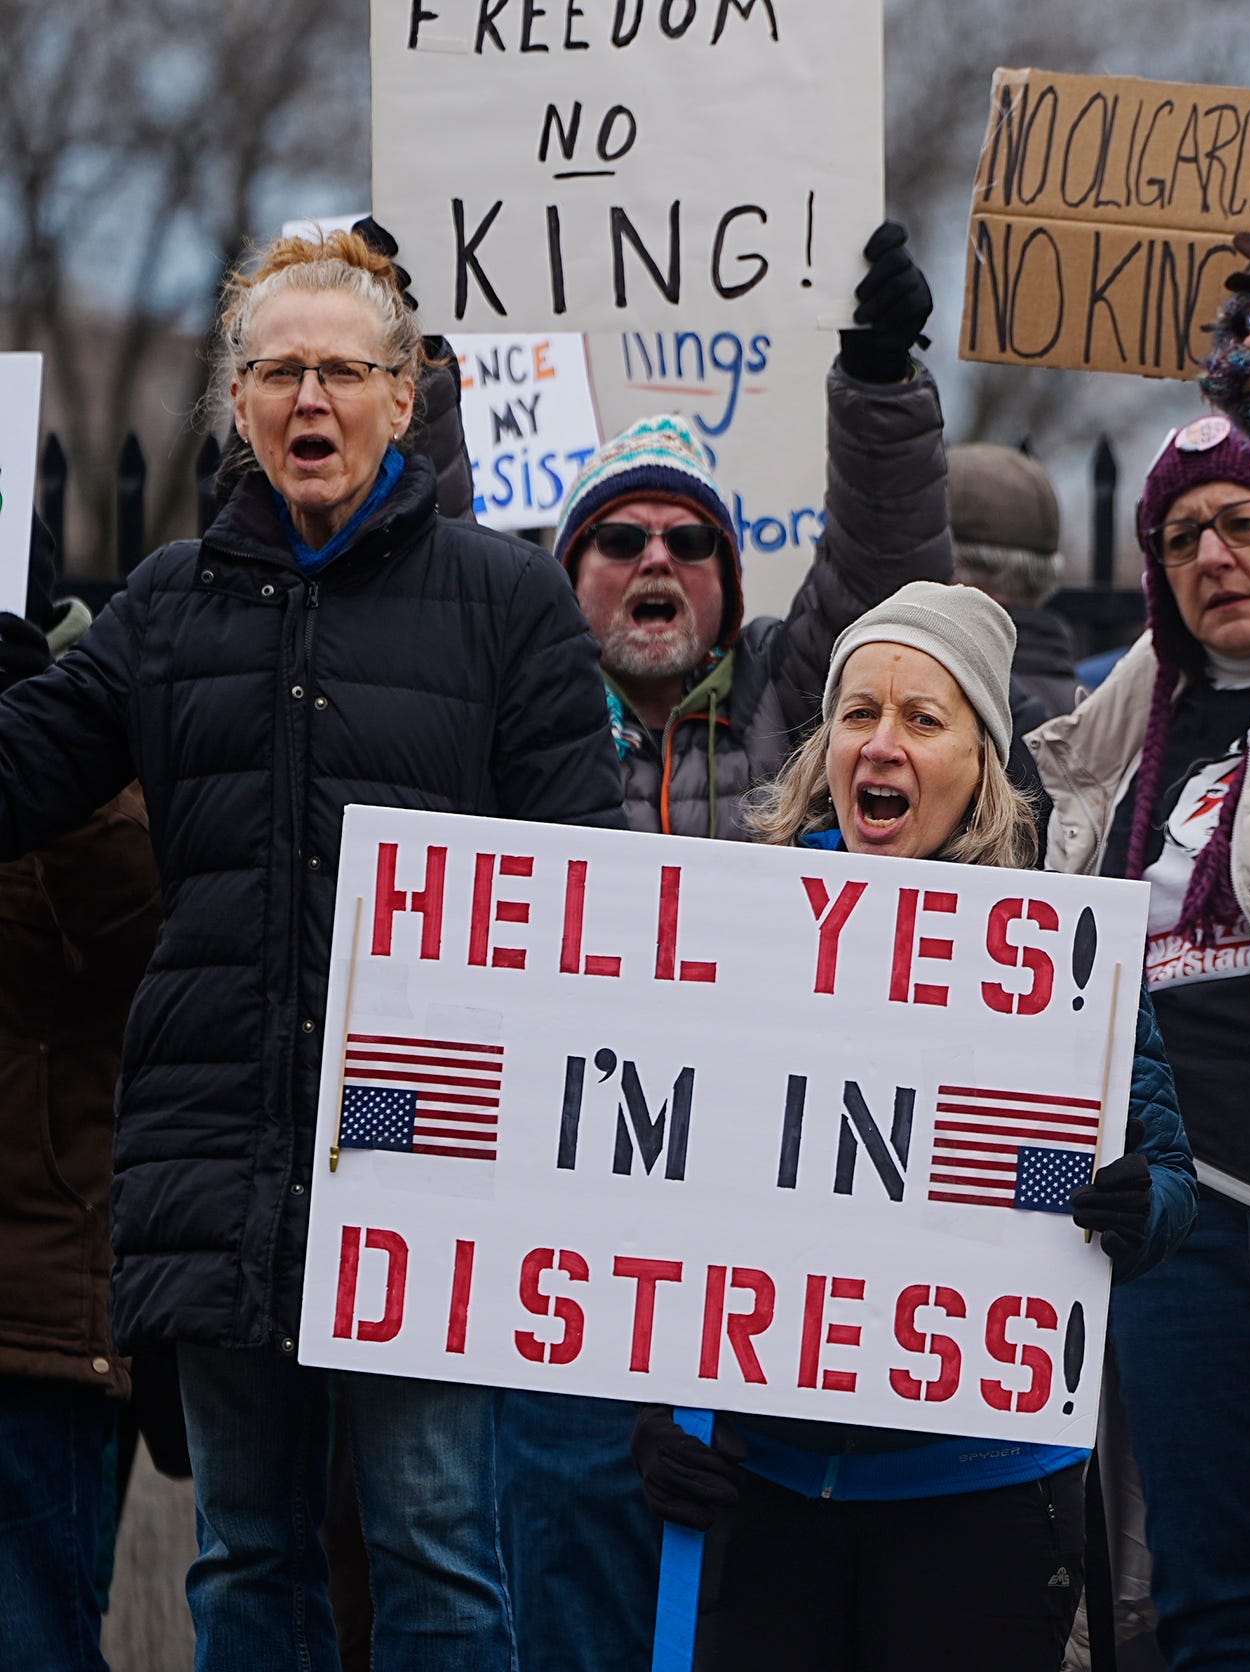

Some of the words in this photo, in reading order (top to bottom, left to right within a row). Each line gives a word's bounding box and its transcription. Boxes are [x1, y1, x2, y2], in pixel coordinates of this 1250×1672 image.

[408, 0, 779, 54] FREEDOM
[538, 101, 637, 163] NO
[983, 84, 1058, 207] NO
[451, 190, 814, 321] KING!
[968, 221, 1064, 359] NO
[490, 393, 541, 445] MY
[369, 842, 718, 983] HELL
[799, 876, 1098, 1016] YES!
[556, 1047, 696, 1182] I'M
[776, 1073, 917, 1203] IN
[331, 1225, 1085, 1416] DISTRESS!
